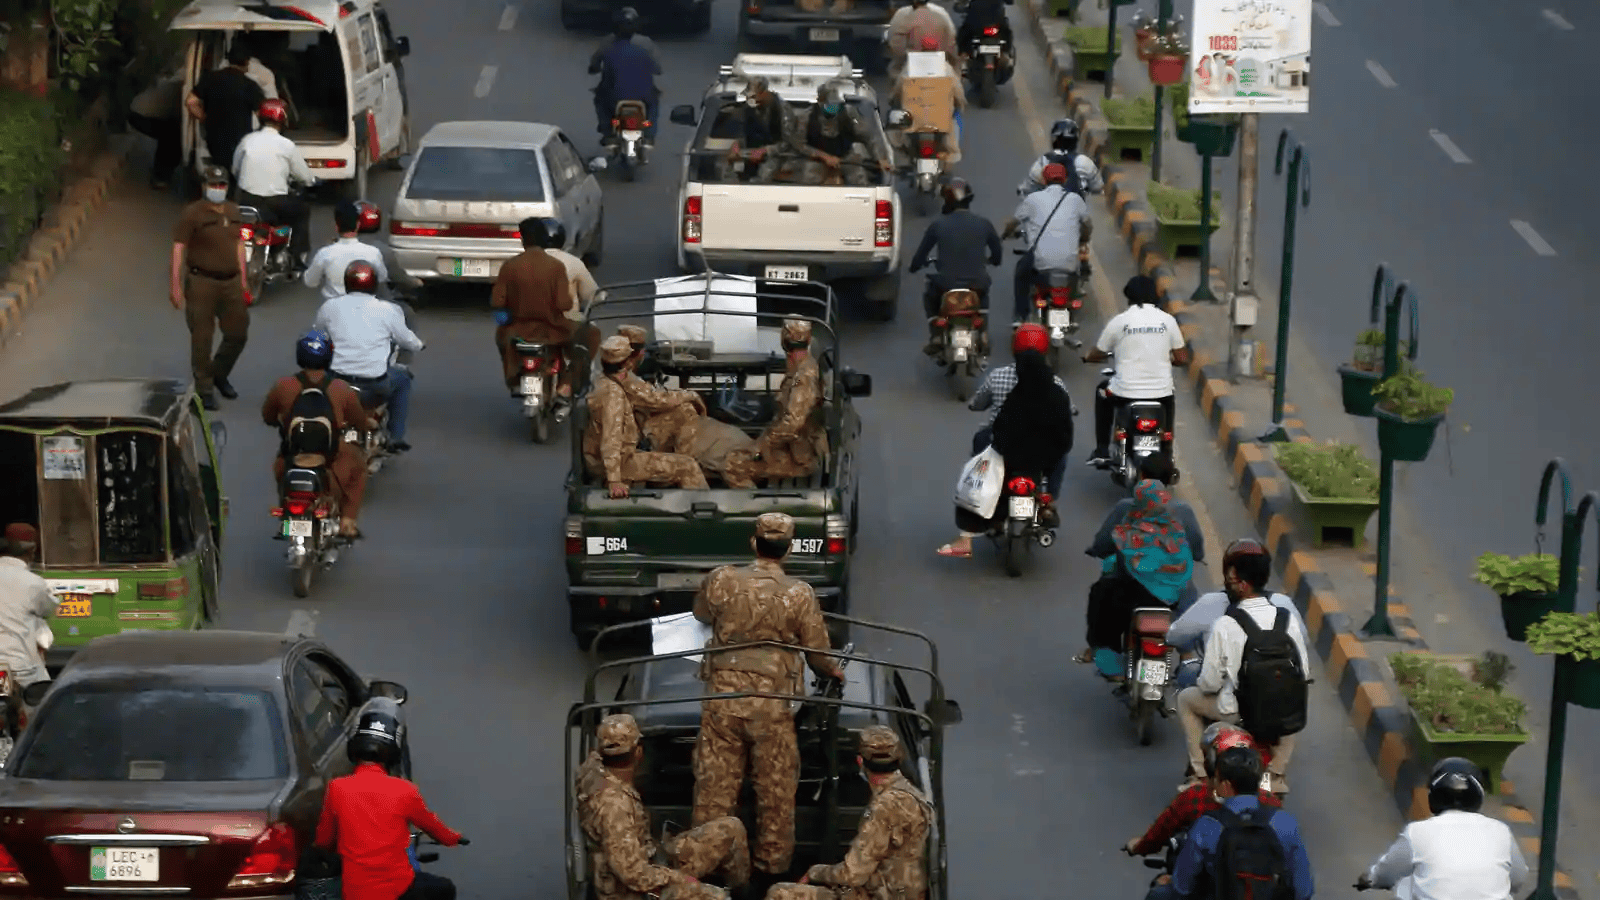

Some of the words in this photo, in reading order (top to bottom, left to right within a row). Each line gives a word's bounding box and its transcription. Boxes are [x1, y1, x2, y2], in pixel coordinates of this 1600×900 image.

[606, 537, 628, 551] 664
[801, 538, 825, 553] 597
[112, 851, 137, 863] LEC
[110, 865, 142, 877] 6896
